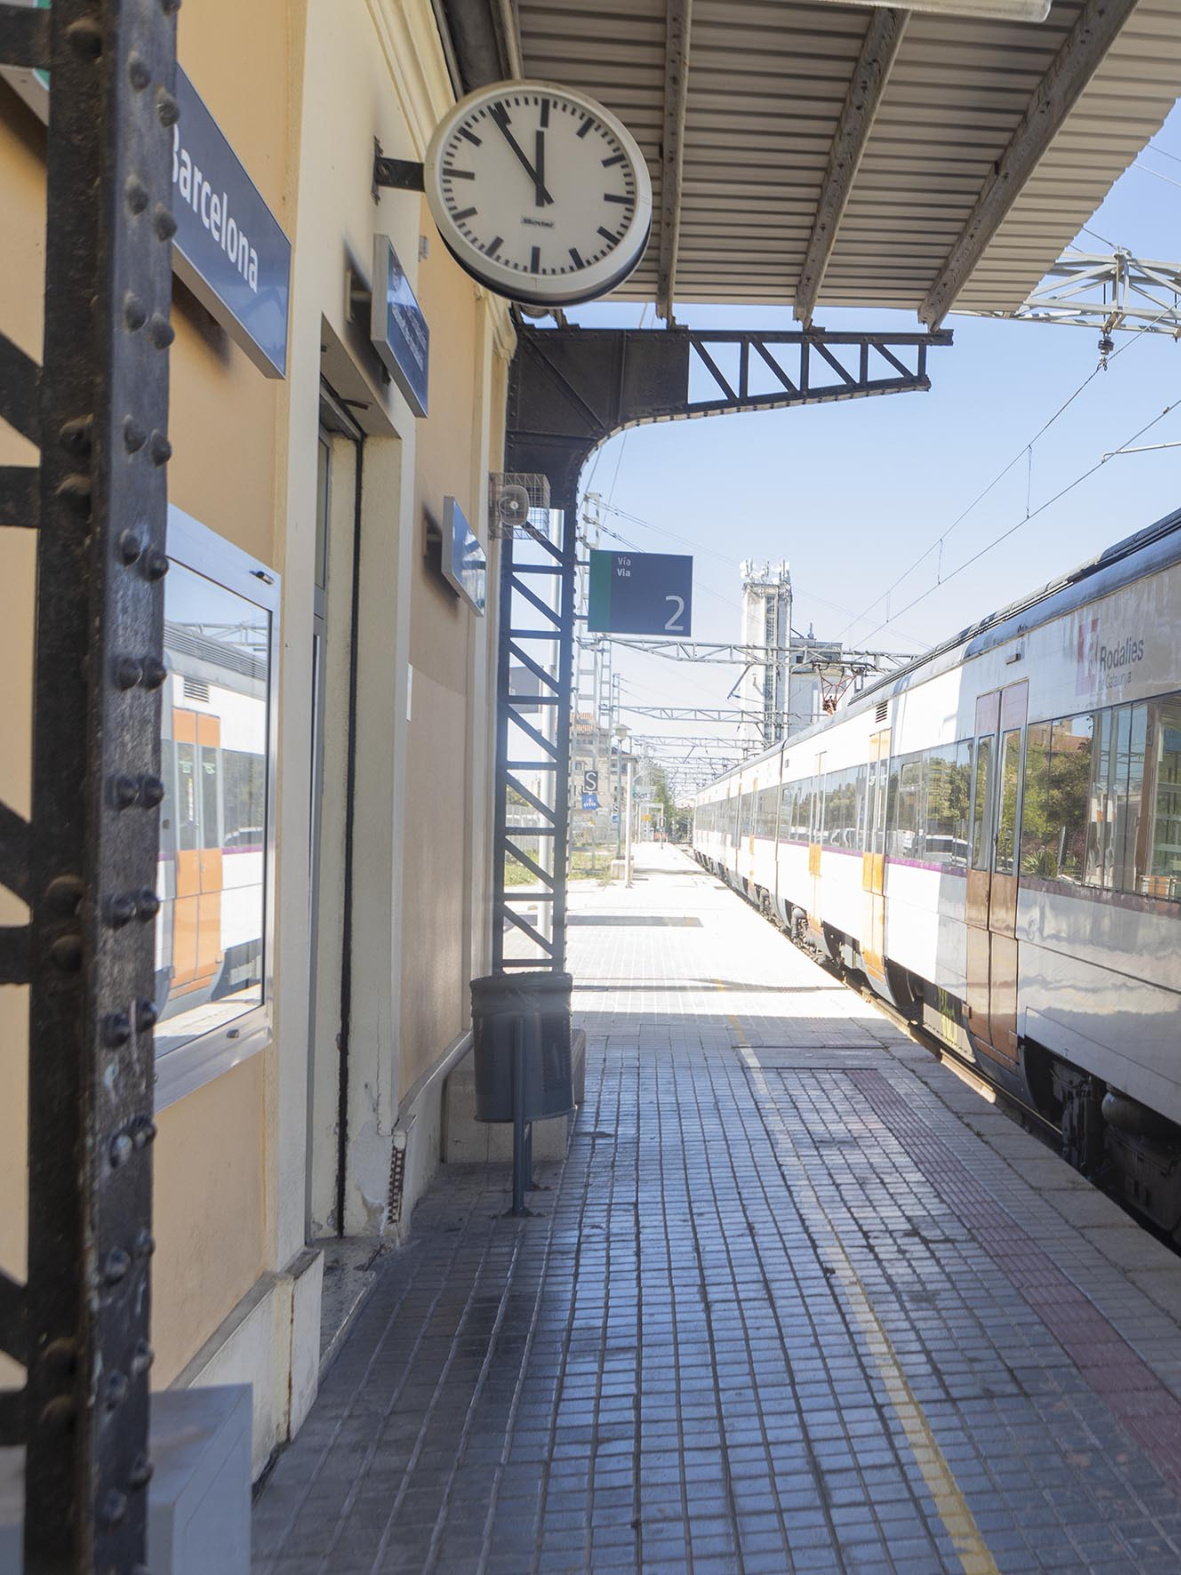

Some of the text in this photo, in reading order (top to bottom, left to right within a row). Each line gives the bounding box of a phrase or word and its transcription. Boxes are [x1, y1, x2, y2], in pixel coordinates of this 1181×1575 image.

[617, 568, 631, 577] Via
[664, 595, 685, 632] 2
[1099, 637, 1144, 672] Rodalies
[585, 772, 597, 790] S
